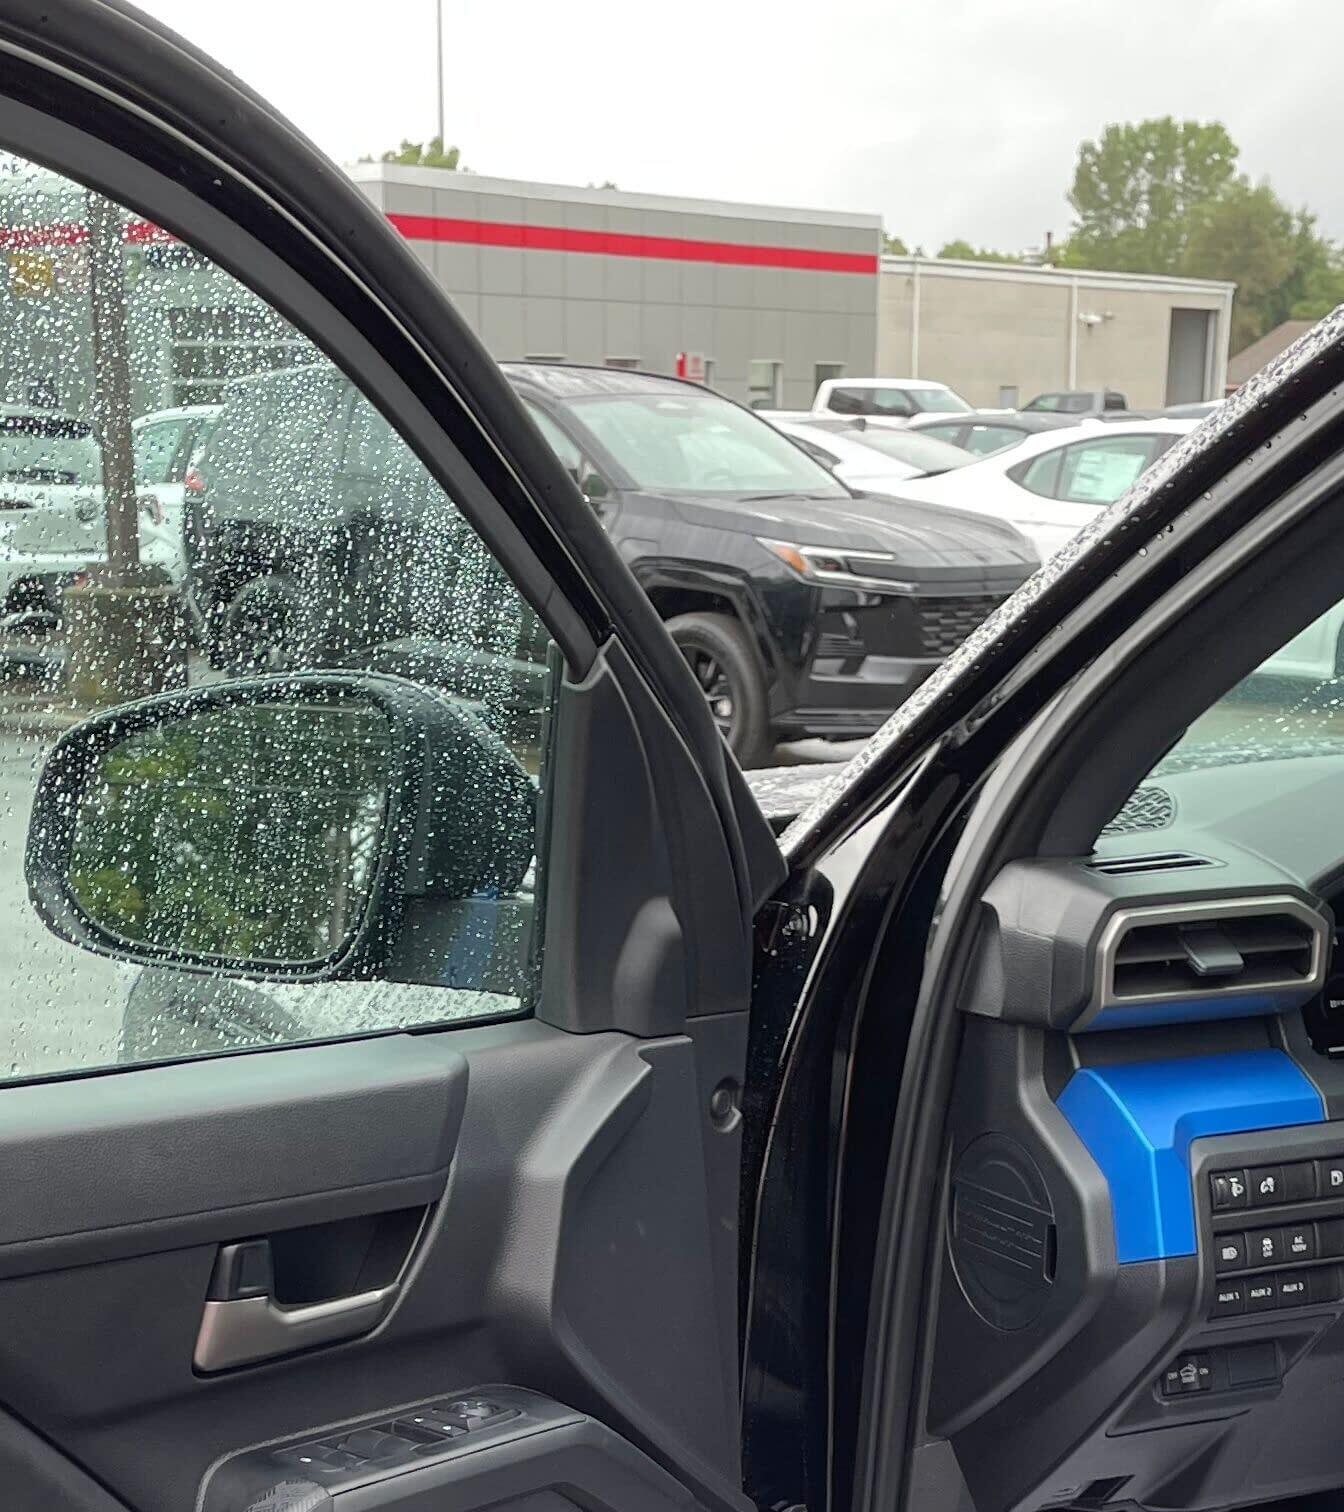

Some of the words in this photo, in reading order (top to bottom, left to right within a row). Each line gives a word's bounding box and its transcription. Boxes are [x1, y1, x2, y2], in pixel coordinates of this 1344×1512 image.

[1283, 1284, 1298, 1293] AUX
[1219, 1293, 1234, 1302] AUX
[1251, 1289, 1266, 1298] AUX
